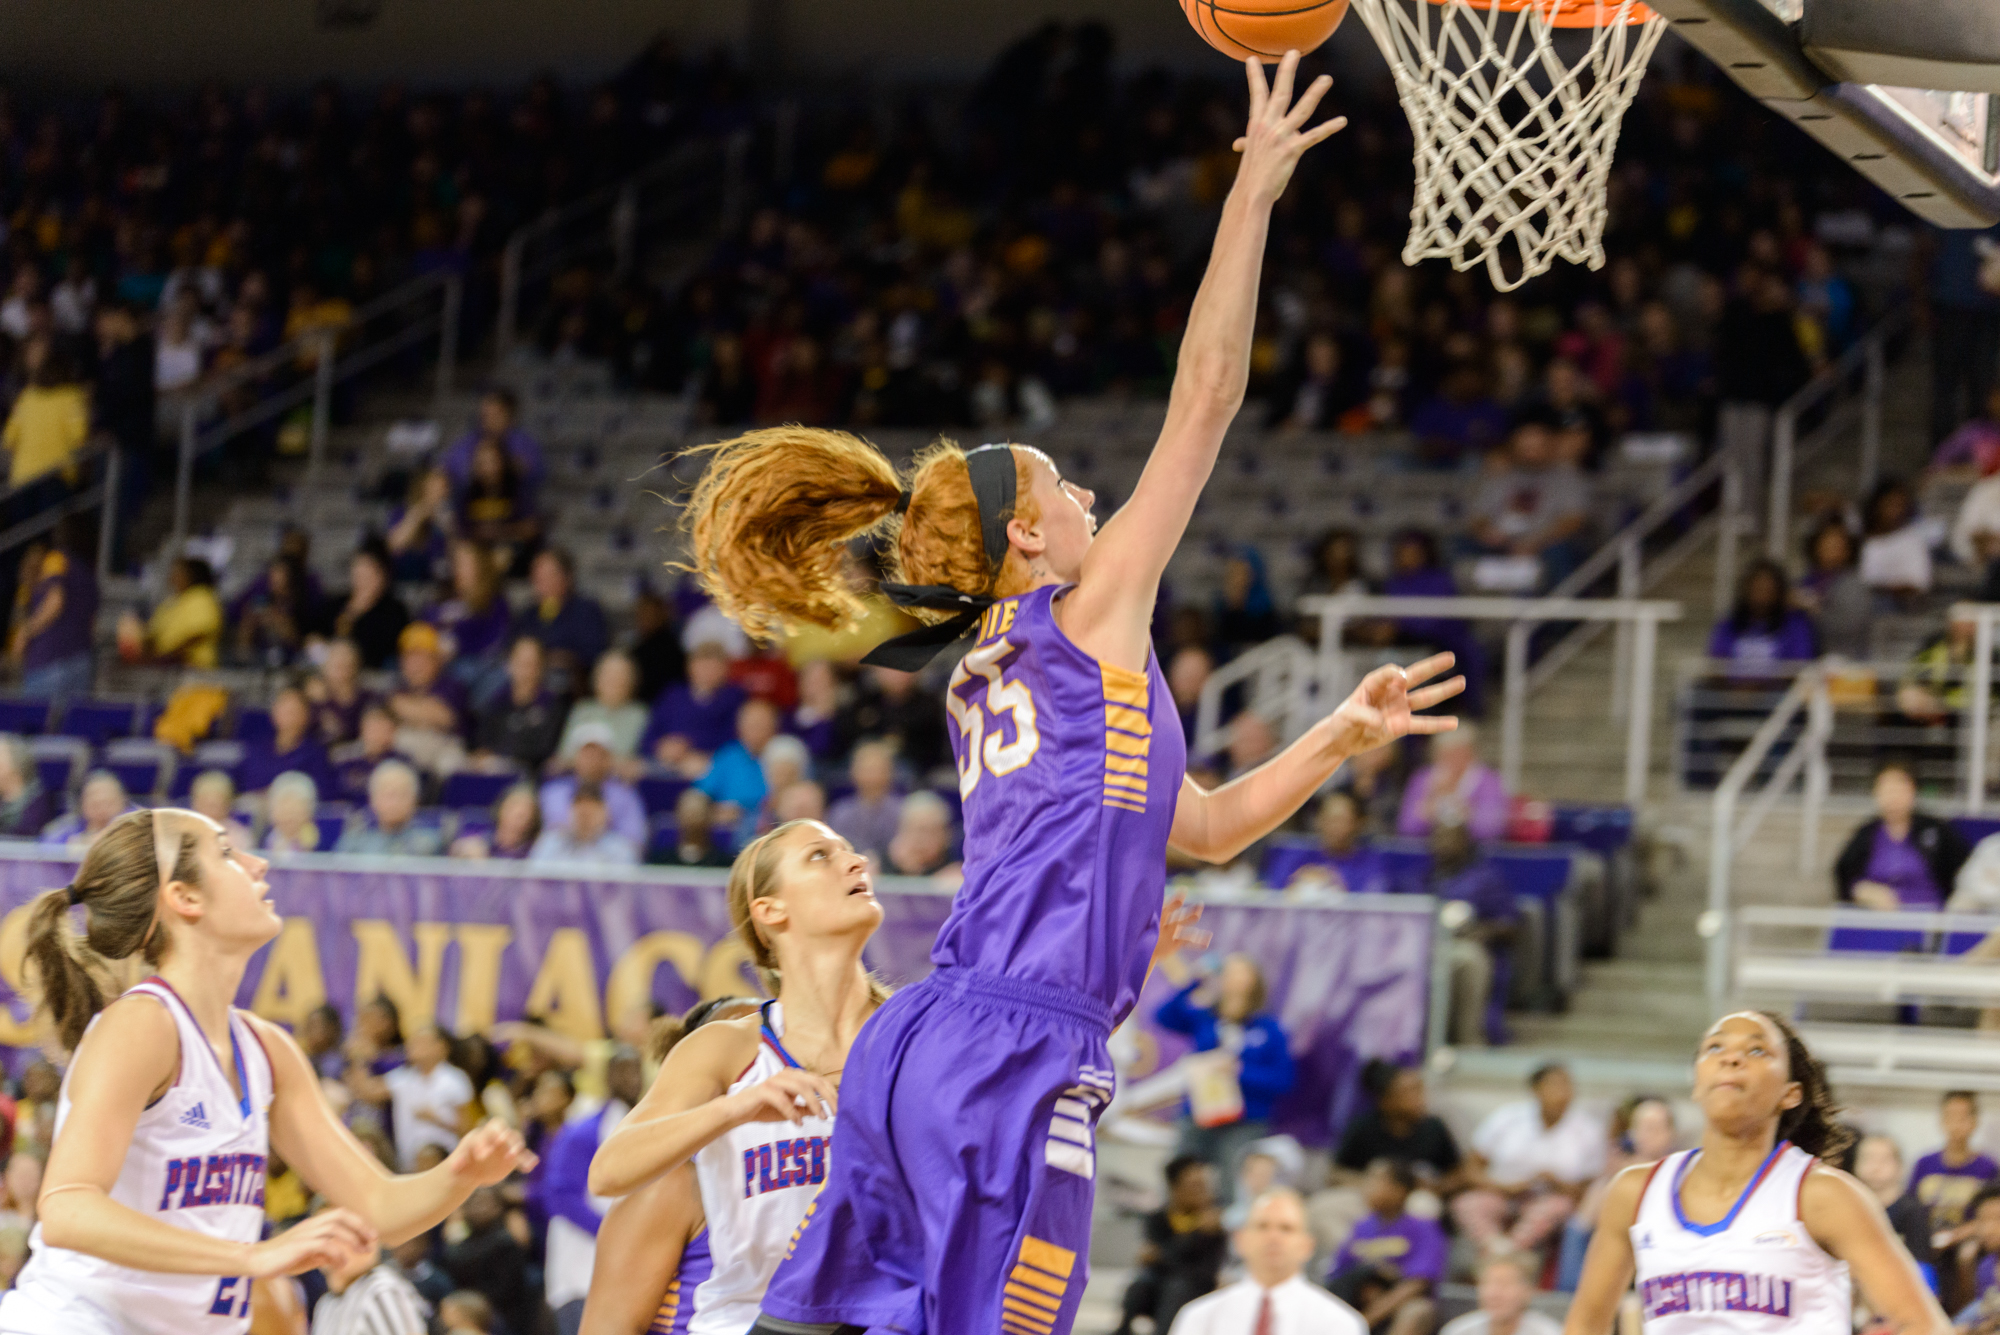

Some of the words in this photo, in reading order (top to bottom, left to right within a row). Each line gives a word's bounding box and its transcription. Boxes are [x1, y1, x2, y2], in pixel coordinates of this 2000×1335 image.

[946, 635, 1040, 802] 55
[124, 915, 768, 1047] ANIACS
[743, 1136, 832, 1200] PRESB
